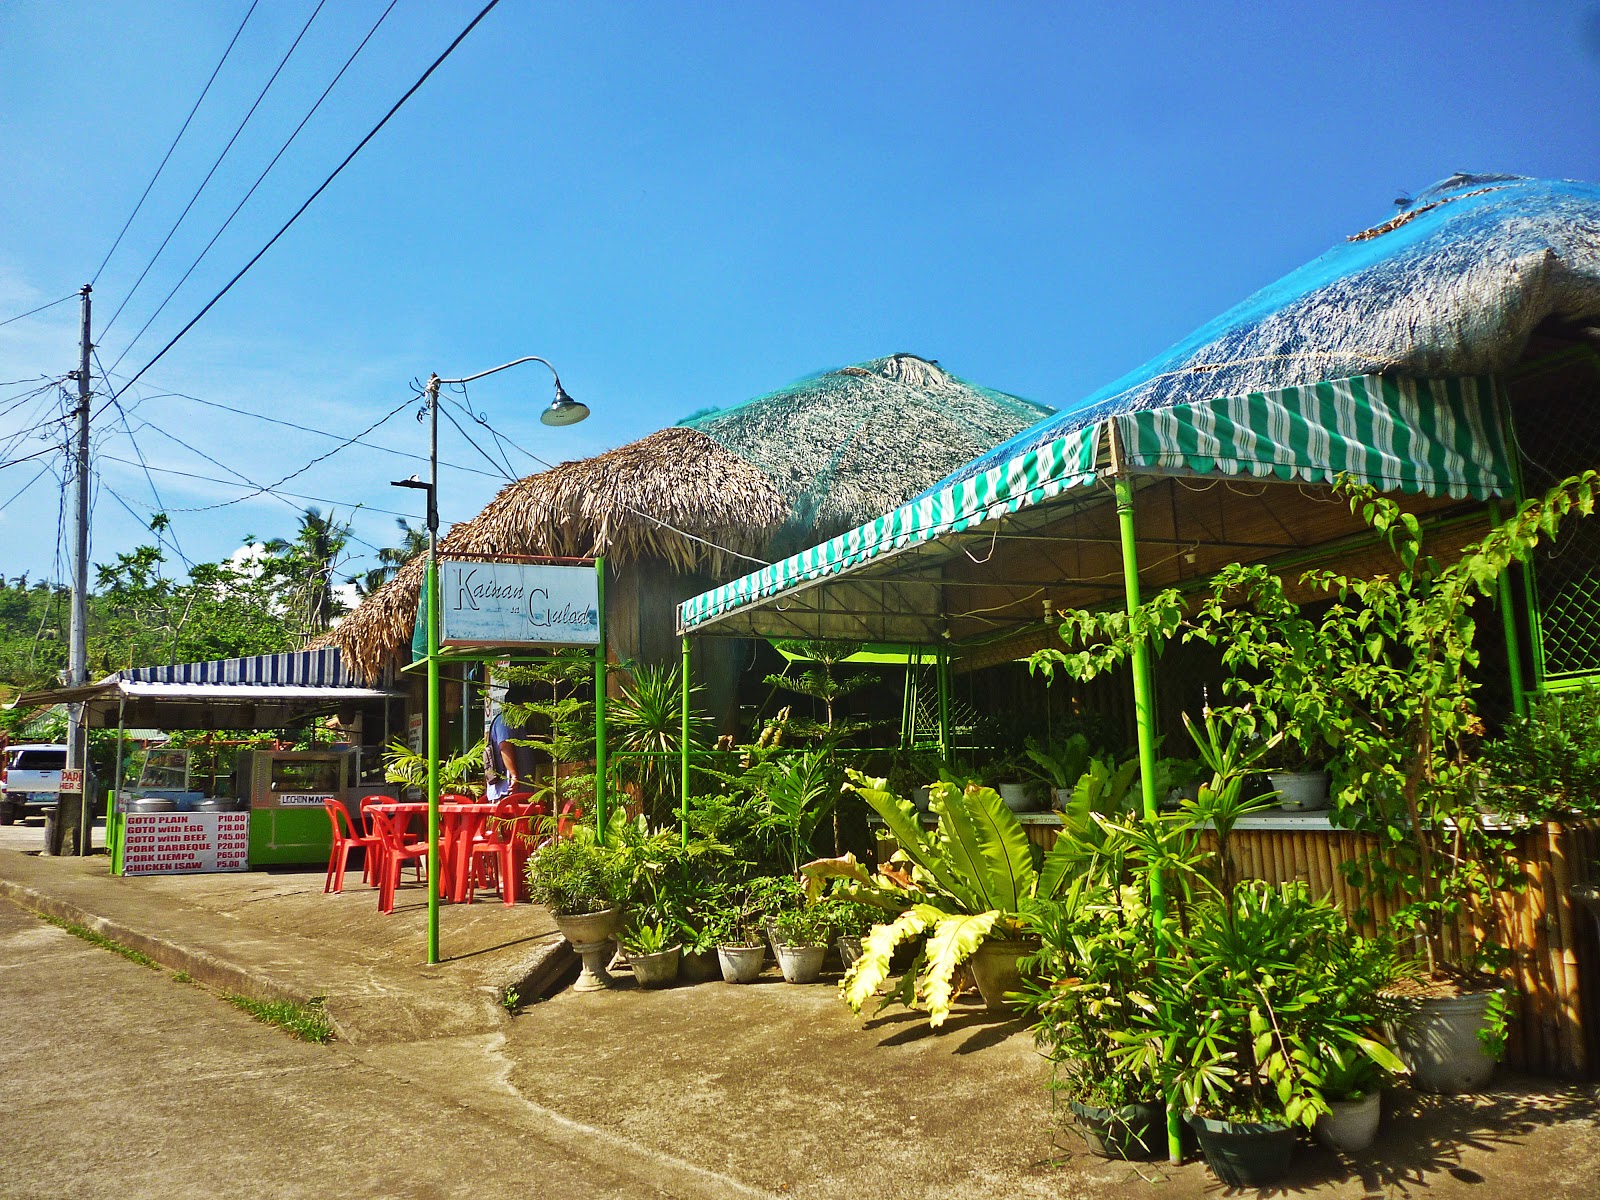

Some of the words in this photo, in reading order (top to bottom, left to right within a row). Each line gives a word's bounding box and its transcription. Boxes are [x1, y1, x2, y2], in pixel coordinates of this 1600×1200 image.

[453, 568, 524, 610] Kainan
[528, 588, 591, 627] Gulod
[158, 843, 211, 852] BARBEQUE
[158, 853, 195, 861] LIEMPO
[126, 863, 172, 872] CHICKEN
